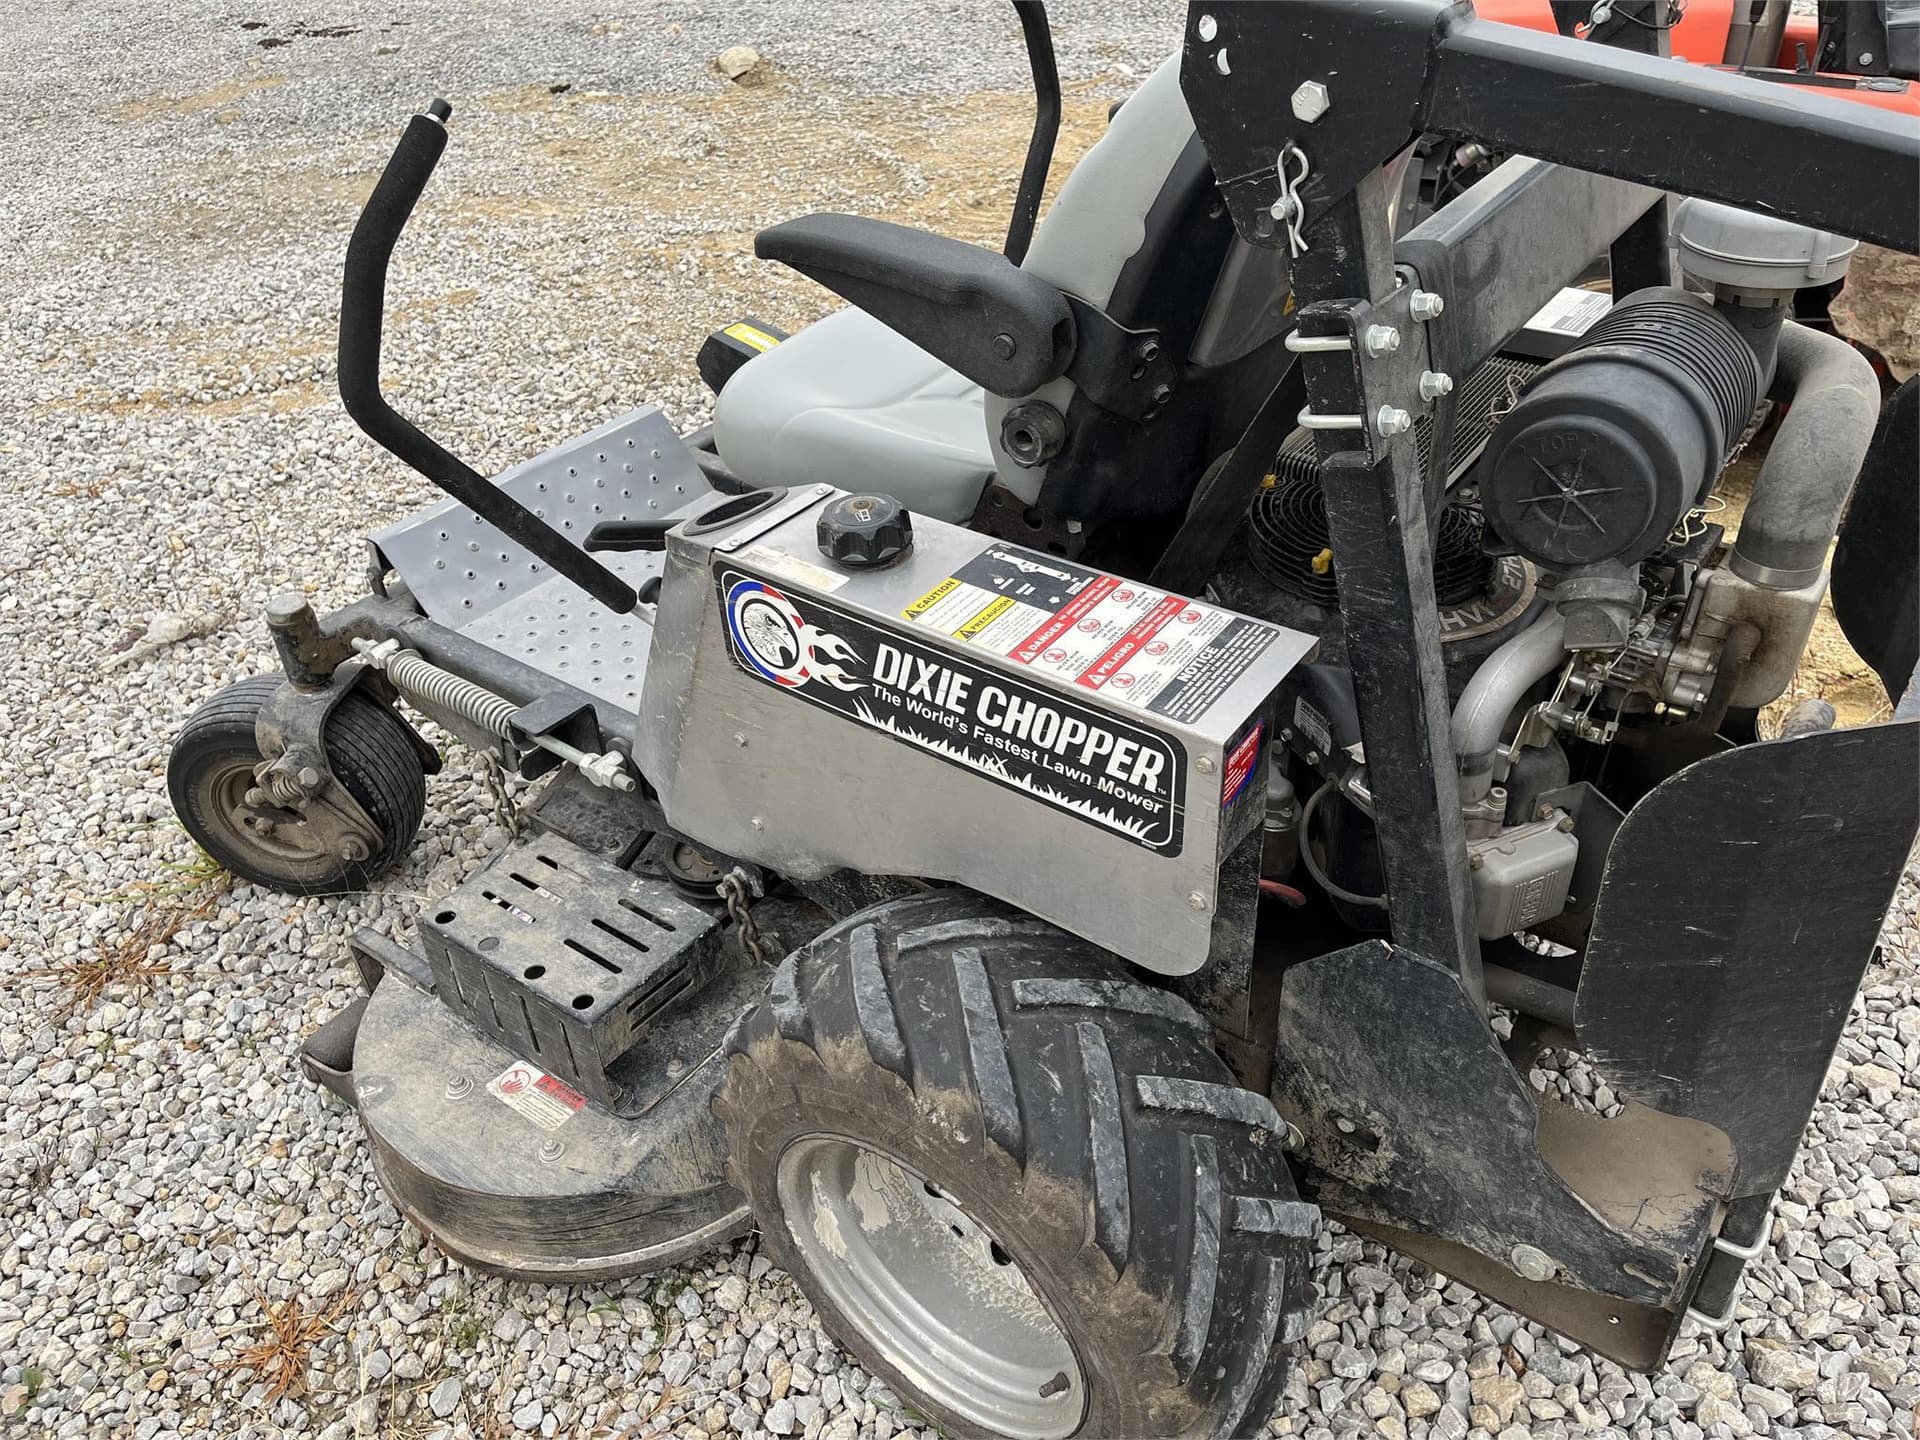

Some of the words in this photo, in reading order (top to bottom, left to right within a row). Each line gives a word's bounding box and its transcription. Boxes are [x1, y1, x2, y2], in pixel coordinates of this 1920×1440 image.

[1537, 433, 1579, 452] TOP
[915, 580, 955, 609] CAUTION
[1030, 622, 1064, 651] DANGER
[1096, 641, 1136, 674] PELIGRO
[1176, 645, 1219, 682] NOTICE
[873, 643, 972, 714] DIXIE
[976, 686, 1164, 792] CHOPPER
[872, 683, 900, 706] The
[905, 698, 968, 734] World's
[973, 725, 1038, 763] Fastest
[1043, 756, 1092, 785] Lawn
[1096, 776, 1164, 813] Mower
